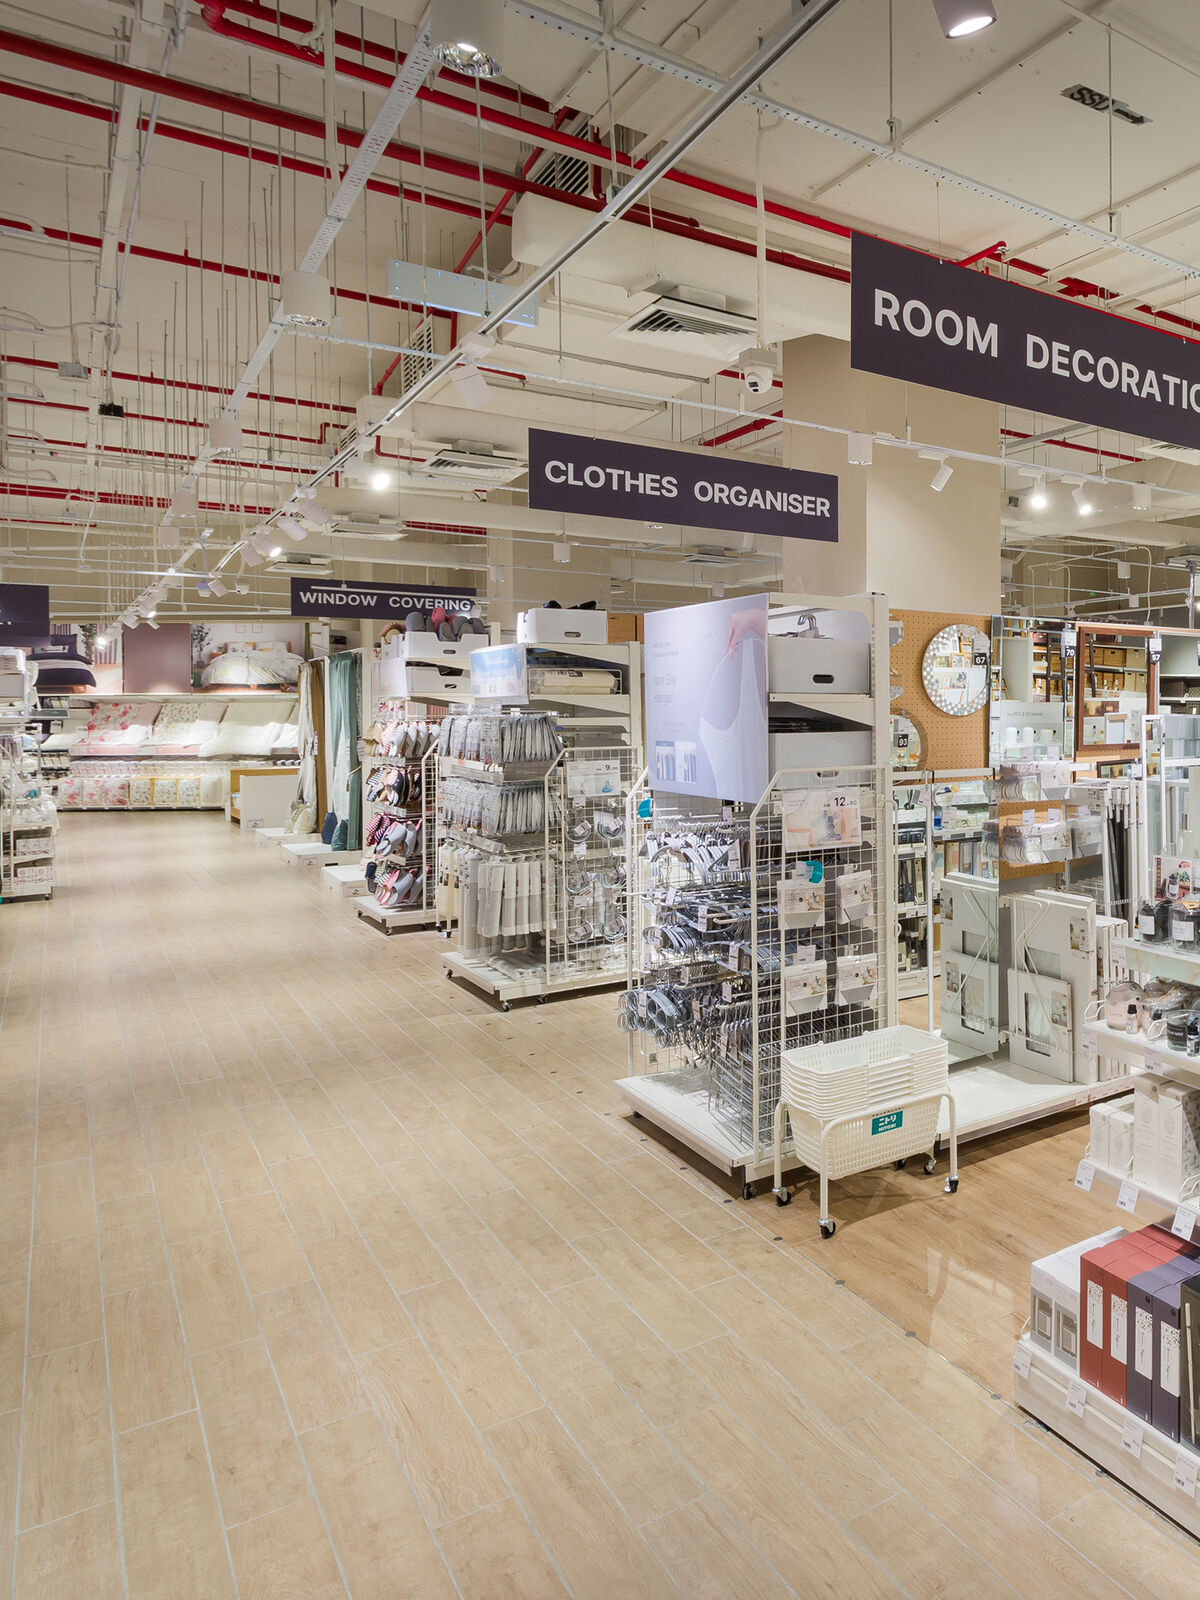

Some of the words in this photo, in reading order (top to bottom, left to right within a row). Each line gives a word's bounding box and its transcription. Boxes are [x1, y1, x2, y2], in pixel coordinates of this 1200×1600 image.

[874, 288, 999, 358] ROOM
[544, 460, 679, 498] CLOTHES
[693, 480, 831, 518] ORGANISER
[299, 591, 378, 607] WINDOW
[389, 596, 471, 612] COVERING
[898, 738, 908, 746] 93
[879, 1114, 897, 1126] ニトリ
